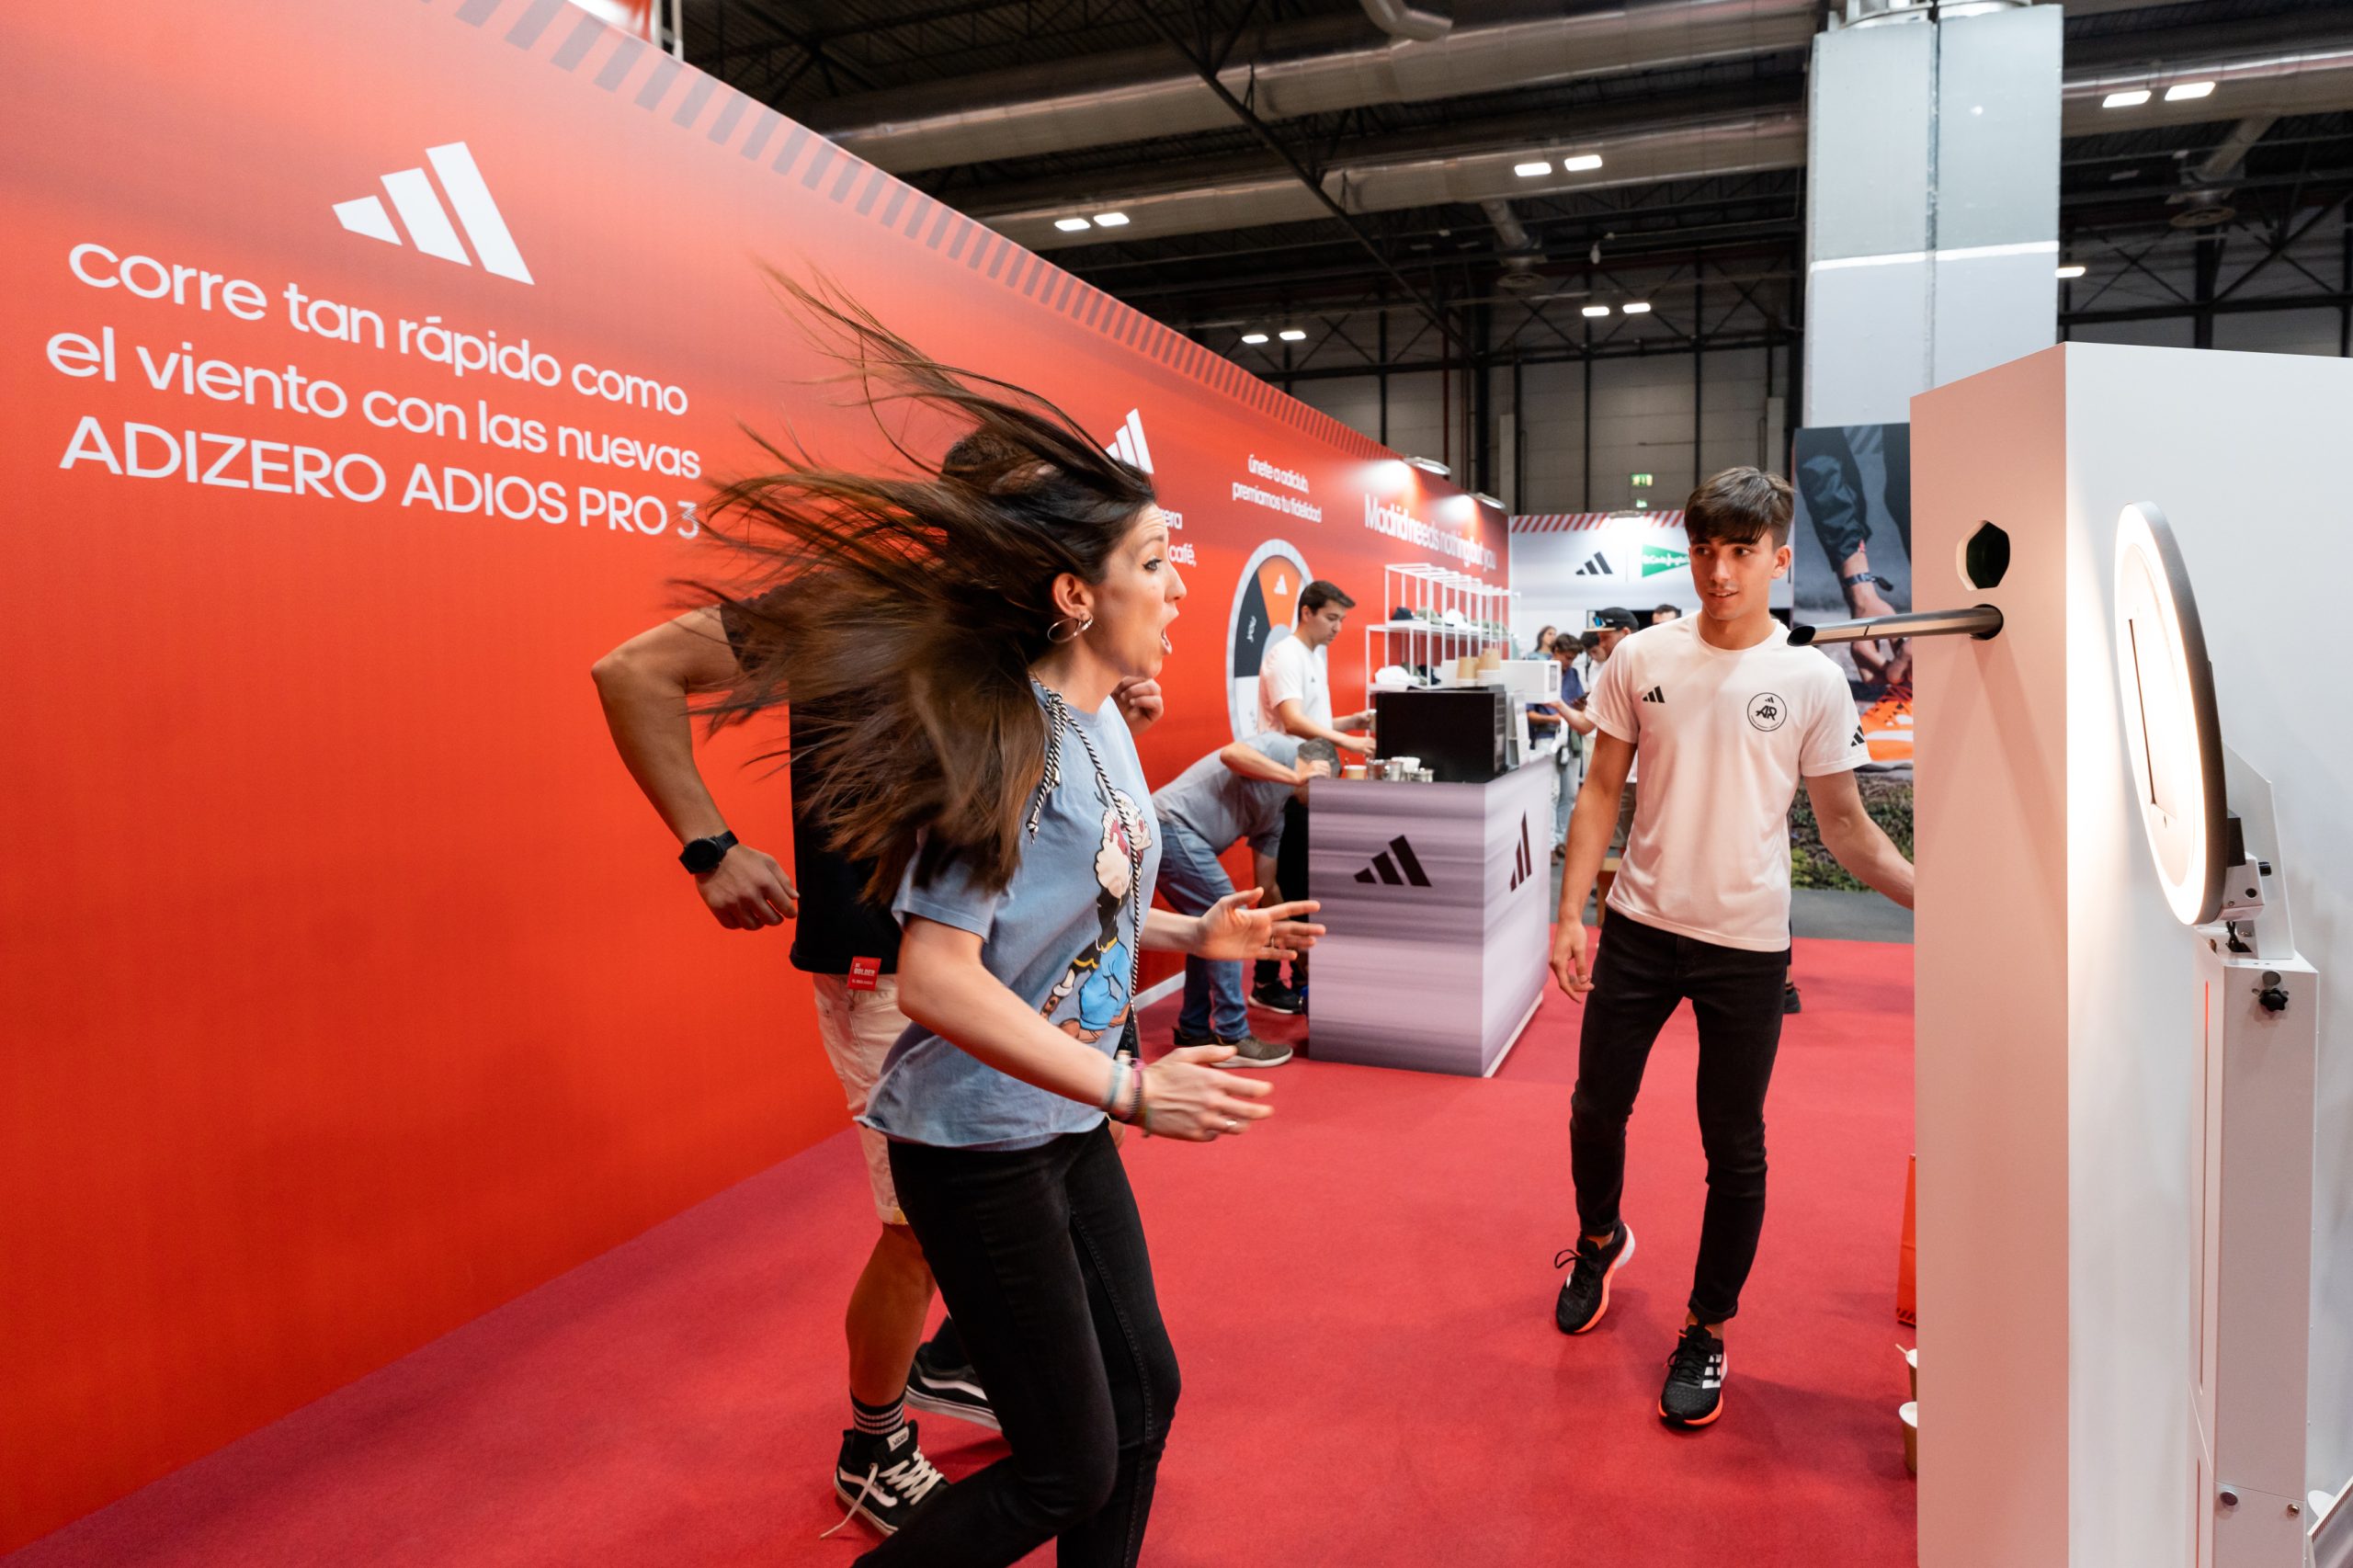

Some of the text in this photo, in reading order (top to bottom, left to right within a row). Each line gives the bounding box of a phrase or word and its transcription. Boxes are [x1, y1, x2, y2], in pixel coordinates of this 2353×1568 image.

[68, 243, 688, 416] corre tan rápido como
[46, 325, 702, 480] el viento con las nuevas
[58, 415, 700, 540] ADIZERO ADIOS PRO 3
[1364, 493, 1409, 541] Madrid
[1408, 517, 1440, 551] needs
